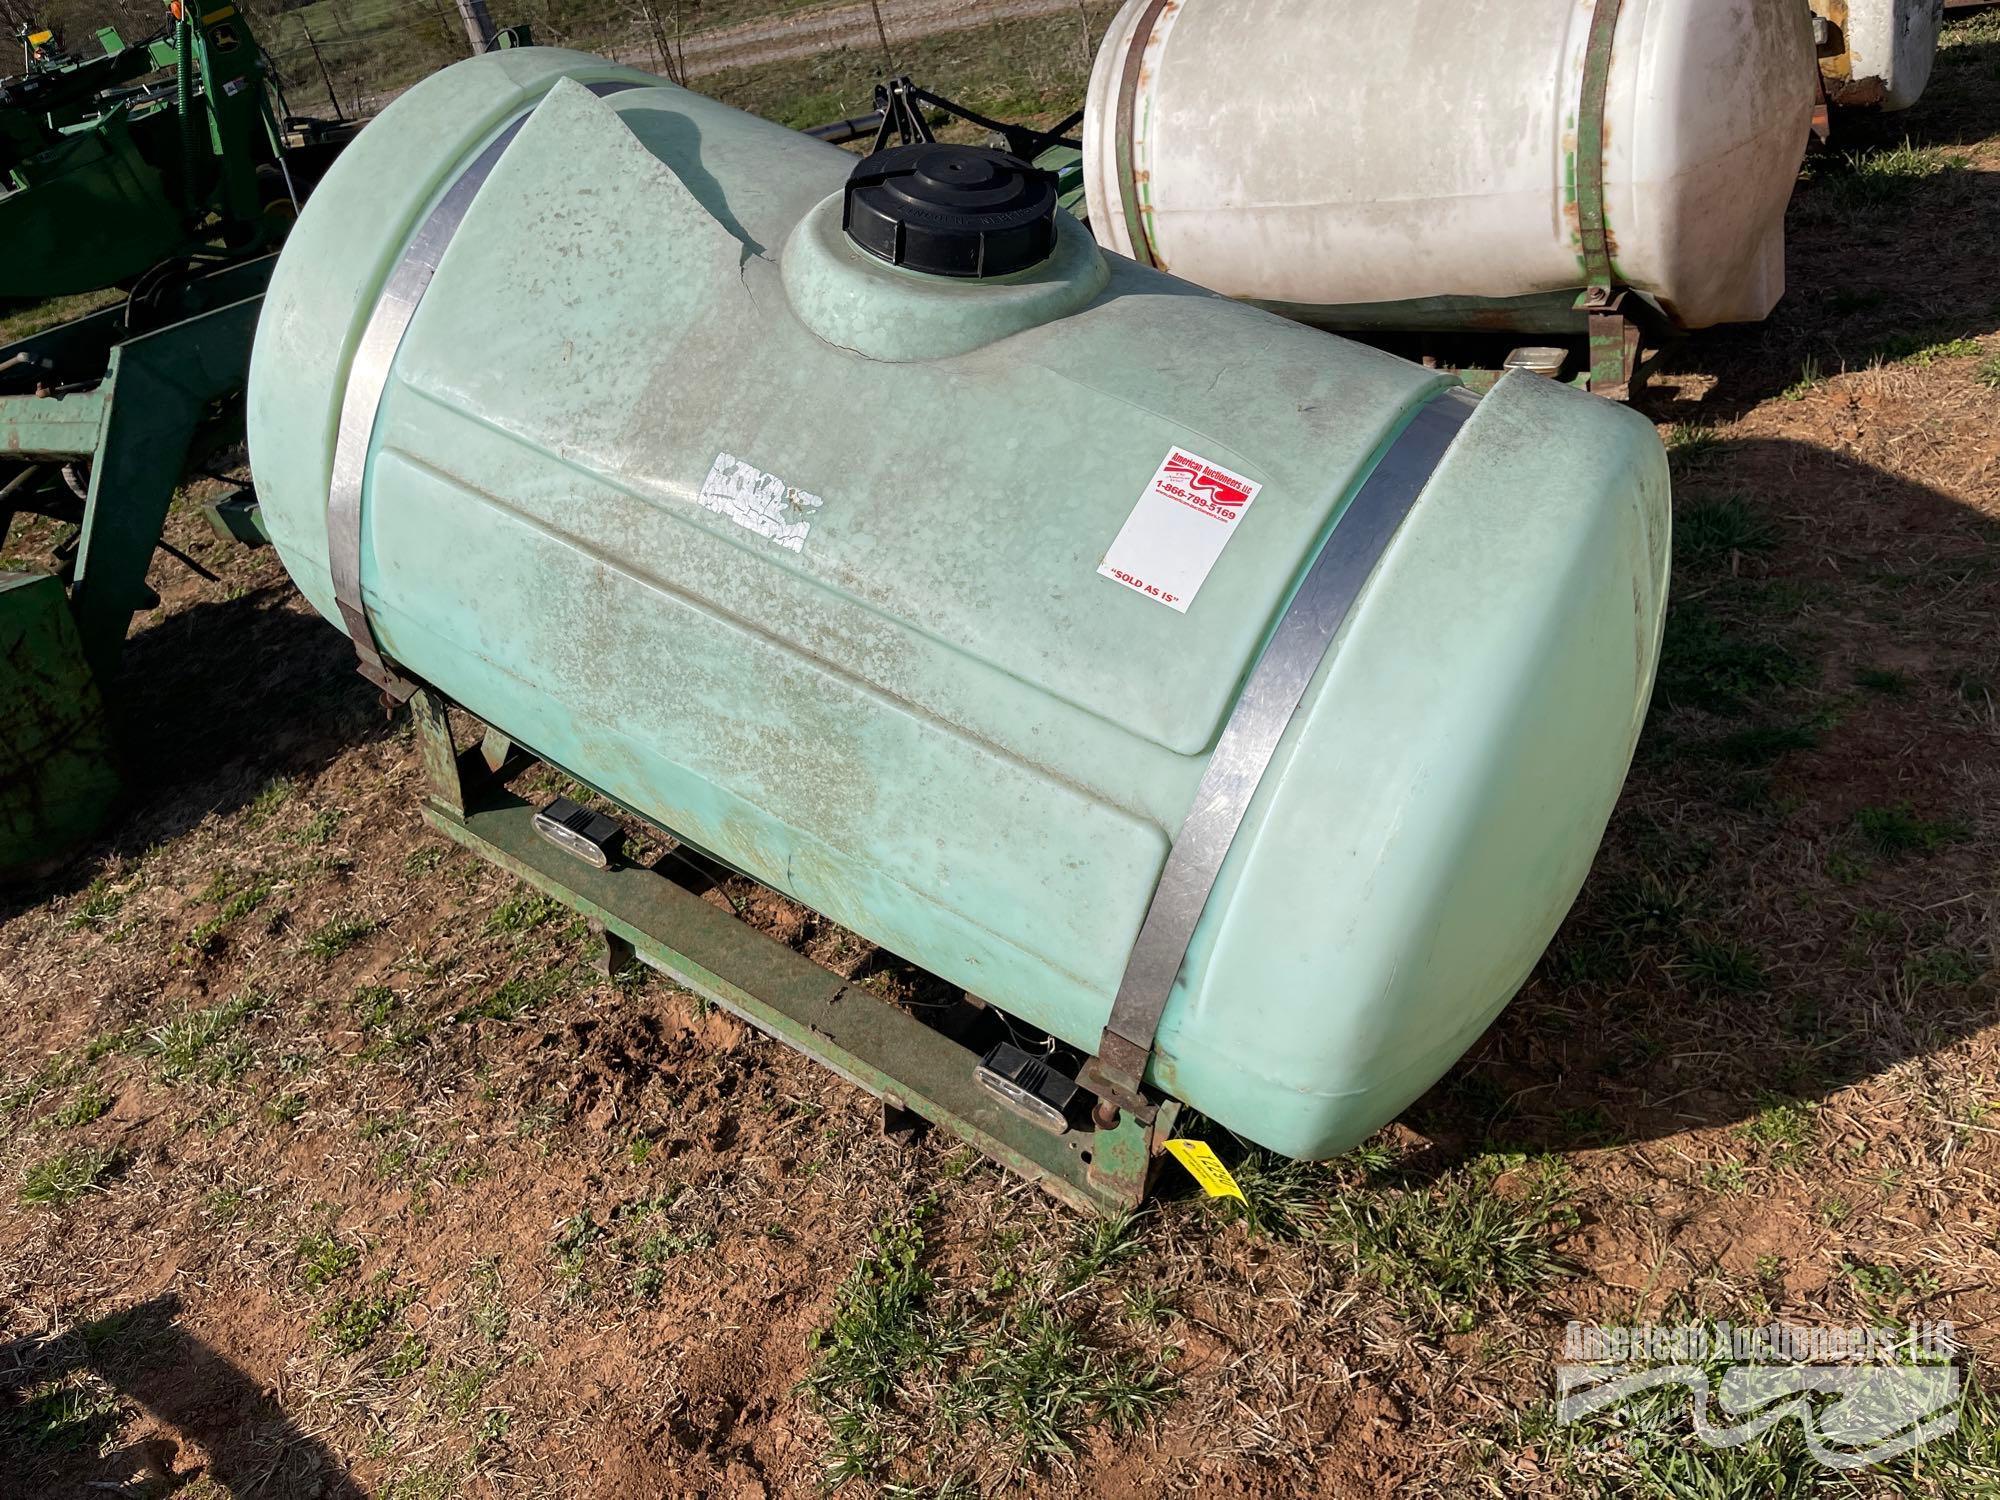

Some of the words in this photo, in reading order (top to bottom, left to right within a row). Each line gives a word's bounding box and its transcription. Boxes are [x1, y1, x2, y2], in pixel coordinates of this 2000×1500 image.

[1172, 452, 1203, 472] American
[1156, 480, 1236, 520] 1-866-789-5169
[1144, 585, 1160, 596] AS
